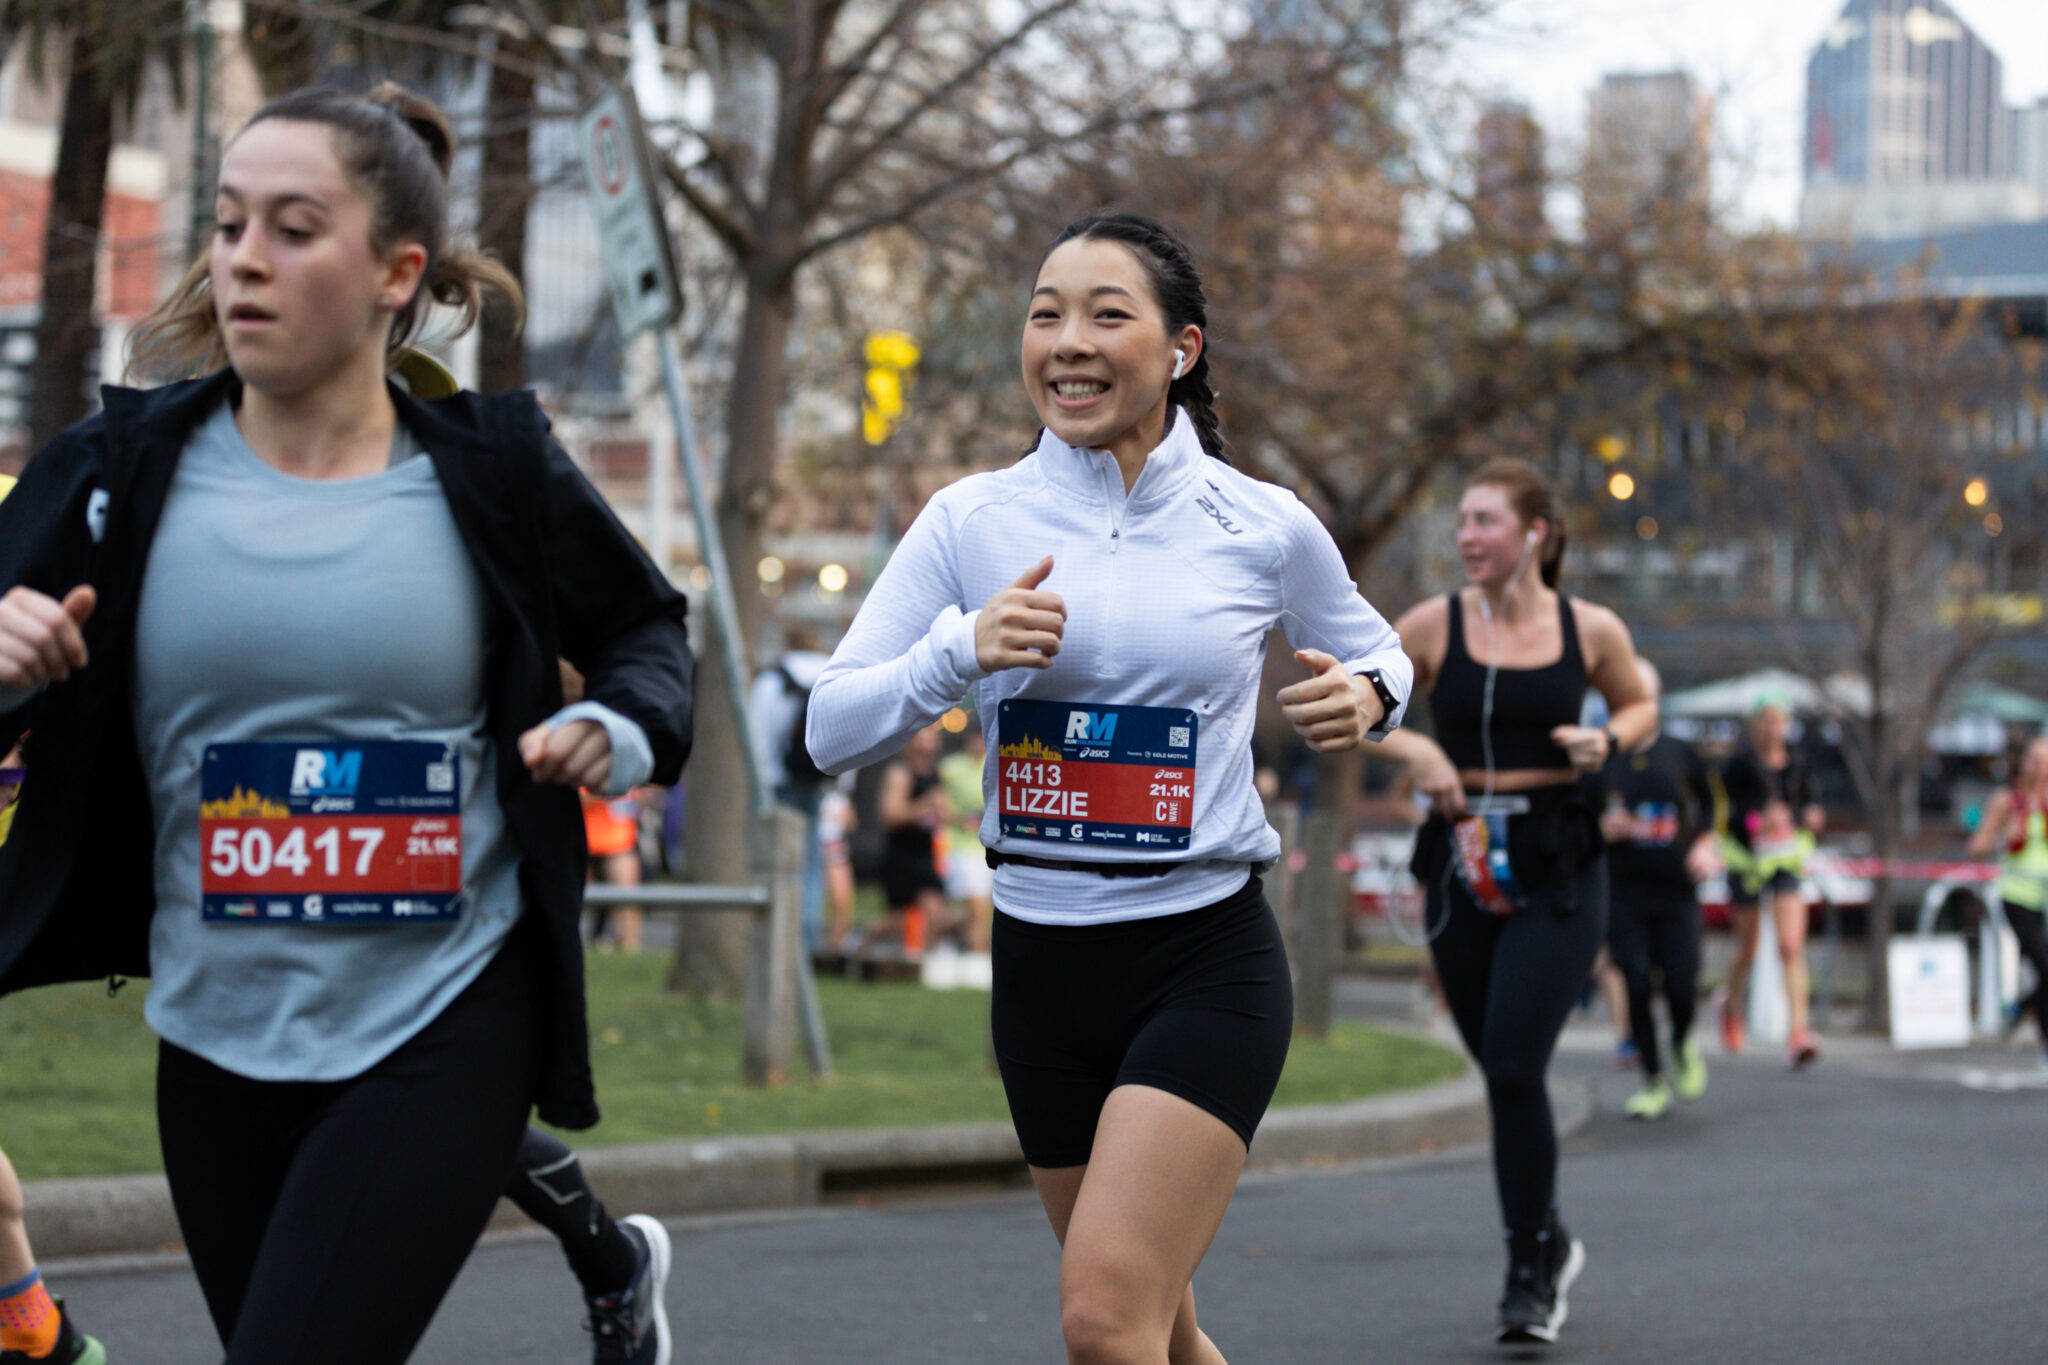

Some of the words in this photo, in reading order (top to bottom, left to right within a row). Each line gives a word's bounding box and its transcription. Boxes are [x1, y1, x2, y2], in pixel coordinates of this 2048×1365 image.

[1195, 496, 1243, 535] 2XU
[1065, 711, 1118, 740] RM
[1006, 762, 1062, 786] 4413
[1006, 786, 1089, 817] LIZZIE
[1149, 783, 1191, 798] 21.1K
[1155, 801, 1167, 821] C
[1168, 802, 1179, 823] WAVE
[210, 827, 385, 876] 50417
